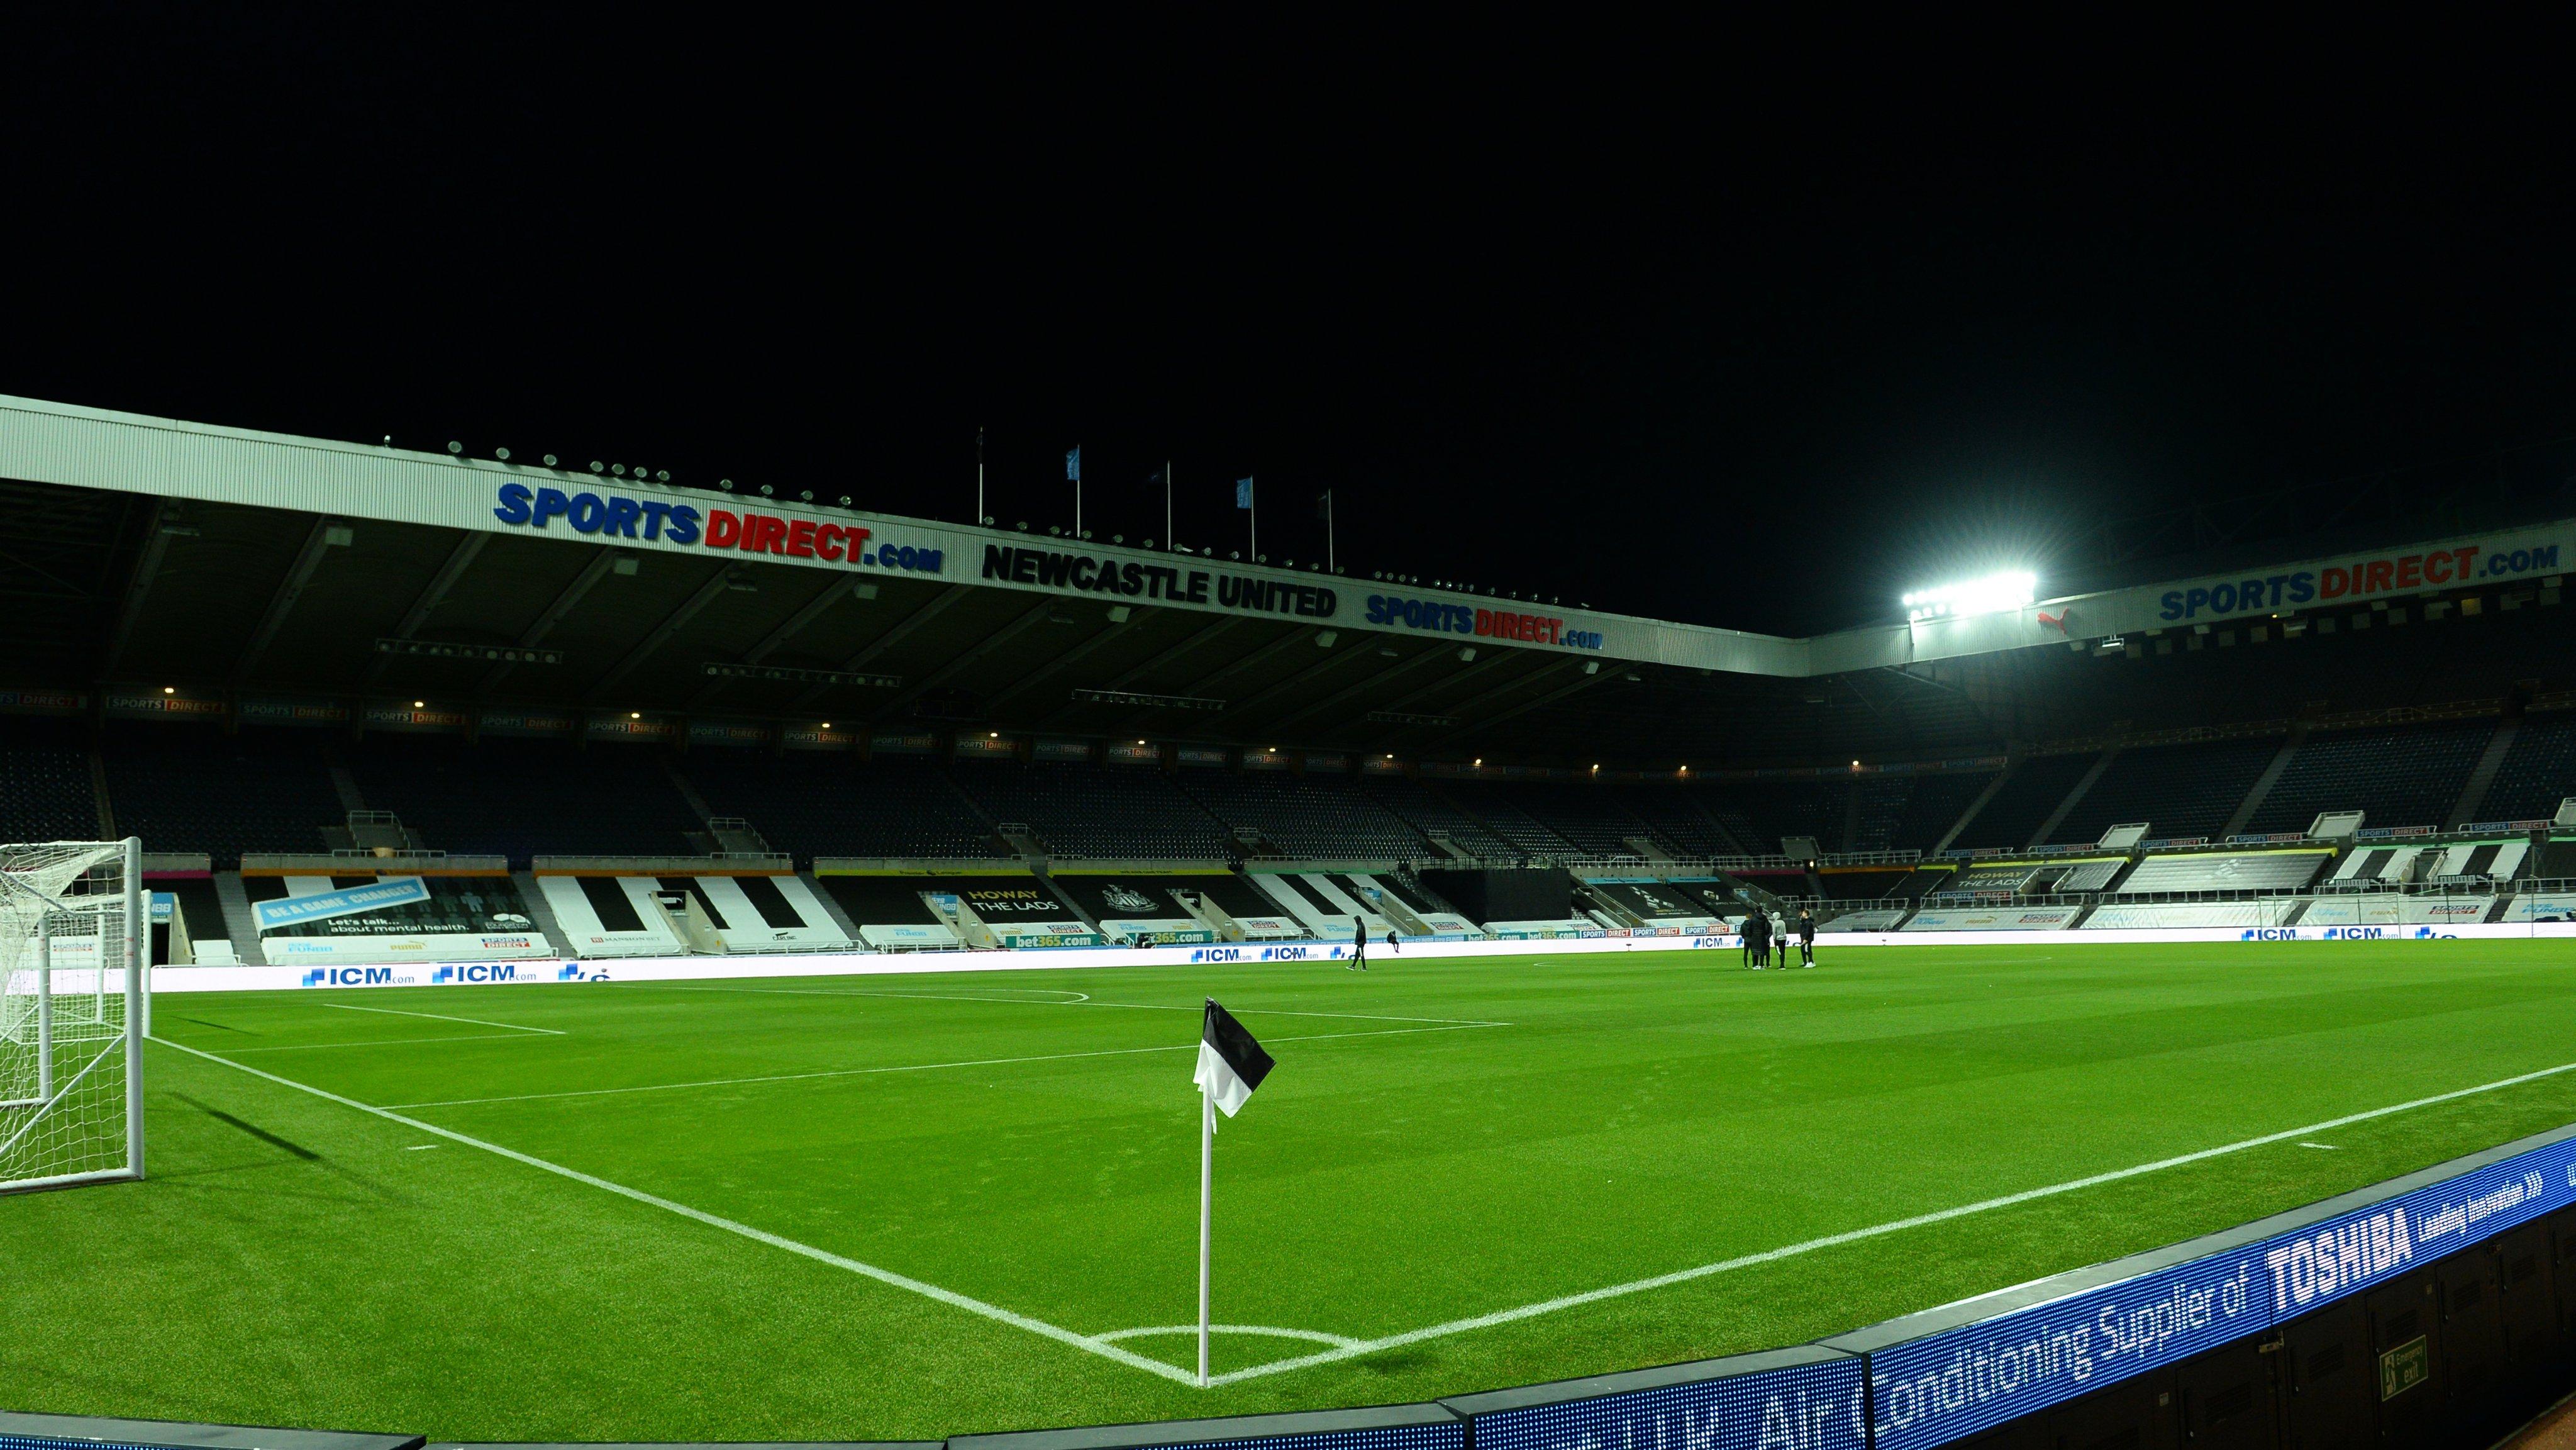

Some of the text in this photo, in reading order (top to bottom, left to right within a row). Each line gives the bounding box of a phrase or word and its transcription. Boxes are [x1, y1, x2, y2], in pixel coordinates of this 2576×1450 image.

[982, 544, 1337, 618] NEWCASTLE UNITED
[111, 698, 218, 712] SPORTS DIRECT
[365, 711, 460, 724] SPORTS DIRECT
[588, 722, 670, 735] SPORTS DIRECT
[784, 732, 855, 743] SPORTS DIRECT
[1036, 744, 1060, 753] PORTS
[1108, 748, 1131, 756] PORTS
[1179, 751, 1198, 760] PORTS
[1245, 755, 1263, 764] PORTS
[1305, 758, 1323, 766] PORTS
[1363, 761, 1380, 769] PORTS
[2360, 827, 2425, 837] SPORTS DIRECT
[2474, 821, 2545, 832] SPORTS DIRECT
[1968, 871, 2026, 879] HOWAY
[968, 890, 1038, 900] HOWAY
[266, 885, 418, 918] BE A GAME CHANGER
[972, 901, 1059, 911] THE LADS
[374, 924, 421, 932] mental
[1016, 935, 1091, 947] bet365.com
[1206, 949, 1252, 962] ICM.com
[330, 968, 414, 985] ICM.com
[458, 965, 537, 982] ICM.com
[1852, 1320, 2092, 1441] Conditioning
[2099, 1282, 2216, 1360] Supplier
[2222, 1259, 2250, 1317] of
[2267, 1207, 2413, 1311] TOSHIBA
[2417, 1202, 2467, 1243] Leading
[2467, 1180, 2524, 1224] Innovation
[2396, 1344, 2423, 1366] Emergency
[2404, 1361, 2419, 1383] exit
